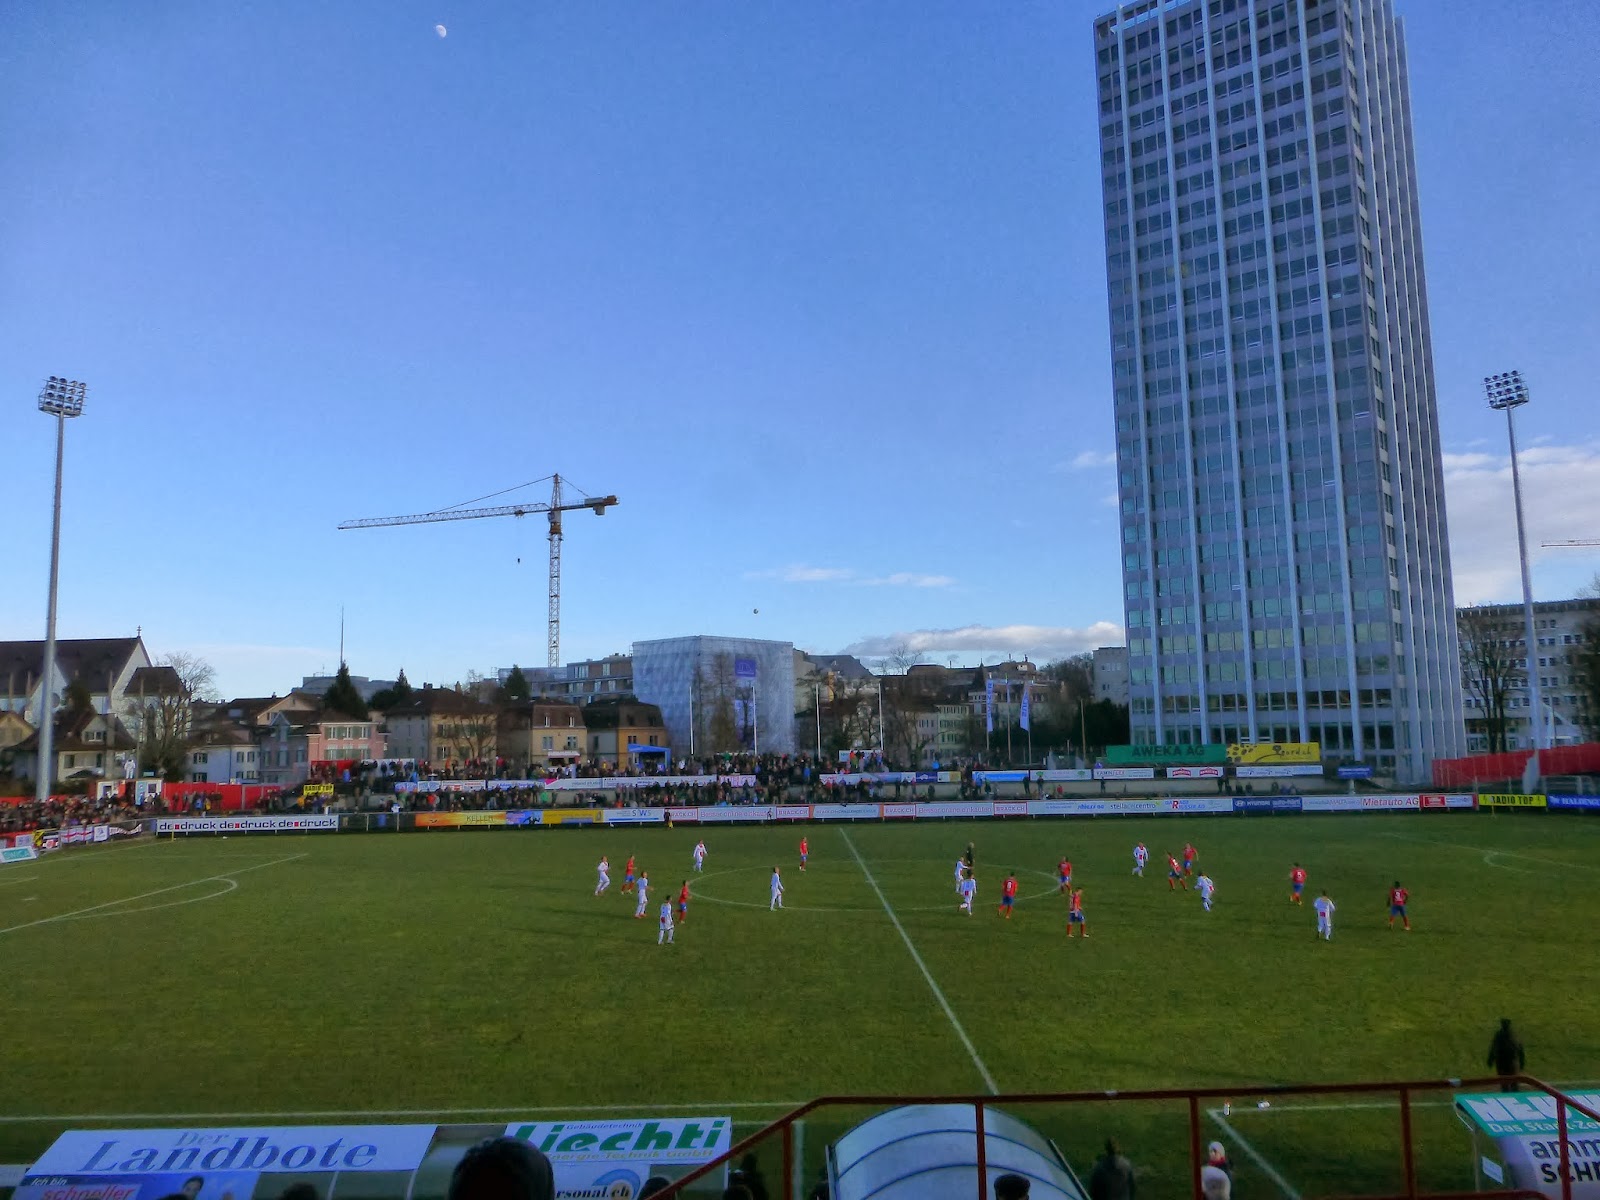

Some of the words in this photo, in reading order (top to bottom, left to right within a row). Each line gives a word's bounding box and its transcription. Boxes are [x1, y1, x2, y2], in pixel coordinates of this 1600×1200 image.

[1363, 797, 1403, 806] Mietauto
[1405, 797, 1419, 806] AG
[1490, 795, 1516, 804] RADIO
[1518, 796, 1534, 804] TOP
[1487, 1123, 1523, 1133] Das
[176, 1132, 229, 1146] Der
[77, 1136, 378, 1172] Landbote
[30, 1178, 48, 1186] Ich
